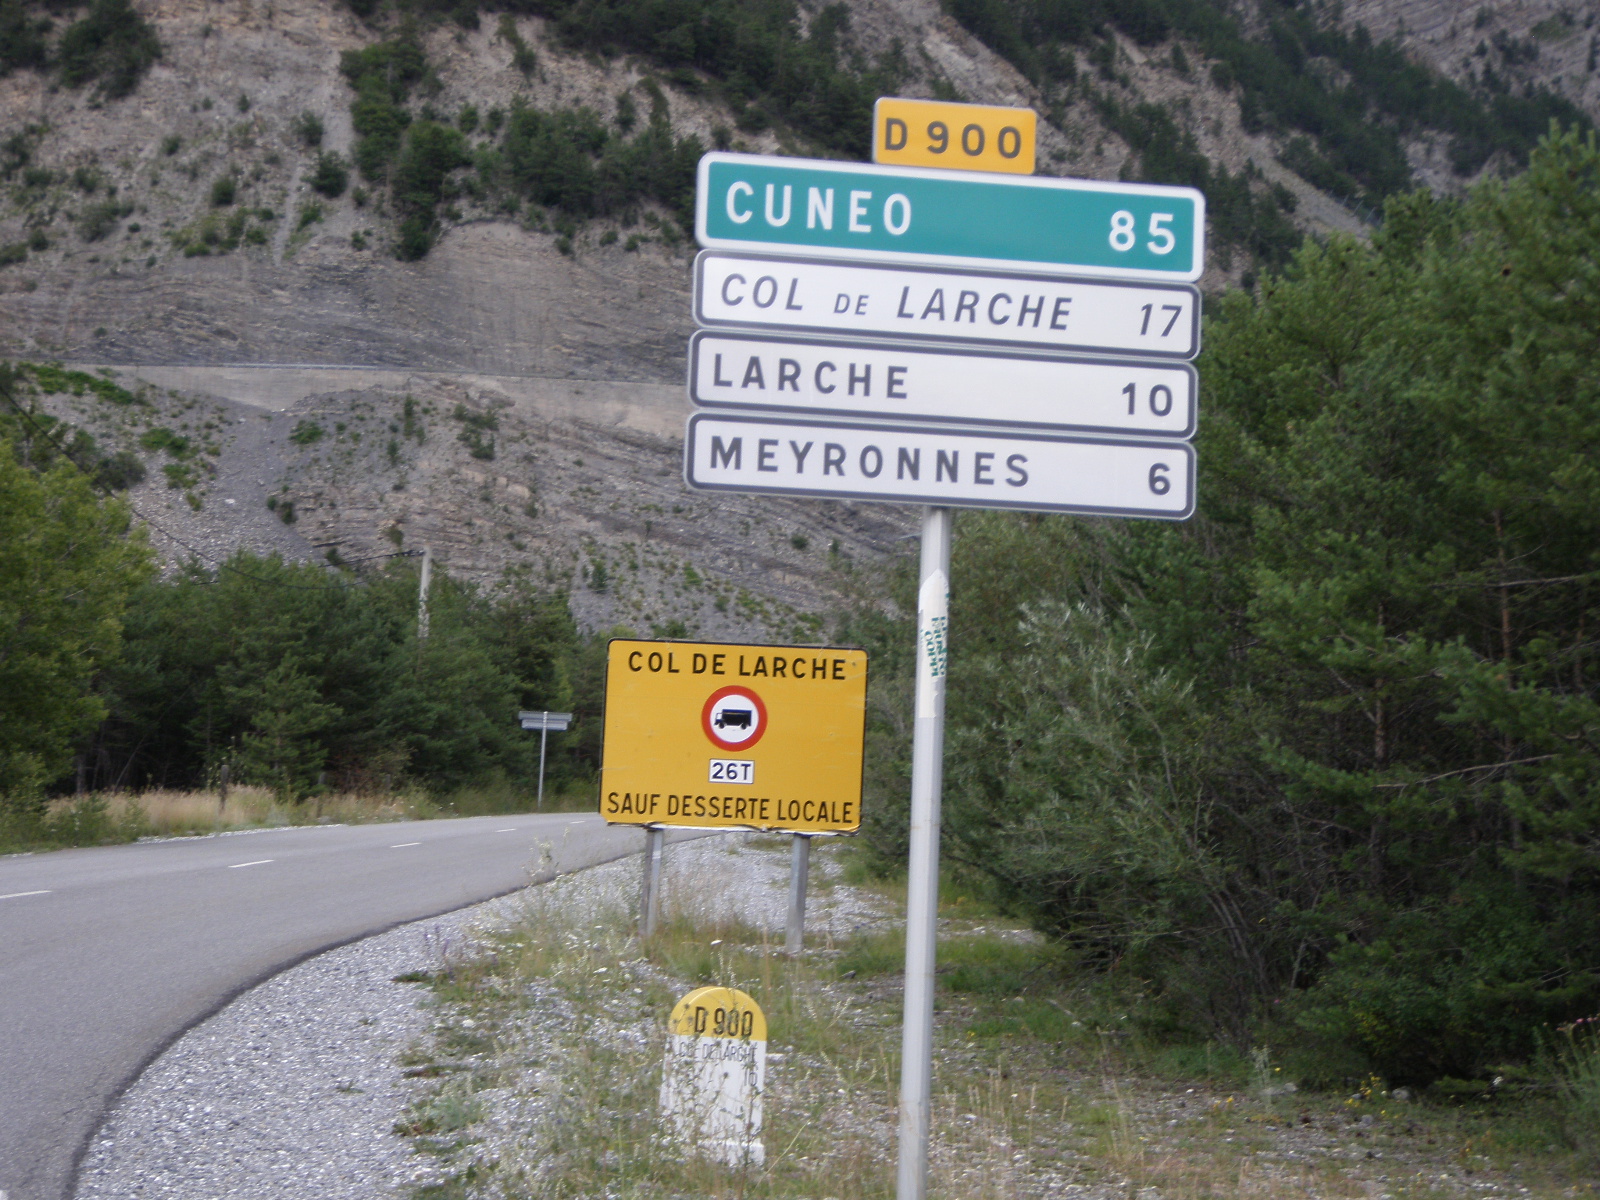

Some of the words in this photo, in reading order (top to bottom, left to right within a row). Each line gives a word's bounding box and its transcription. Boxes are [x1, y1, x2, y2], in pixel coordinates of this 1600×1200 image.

[884, 117, 908, 151] D
[926, 120, 1021, 159] 900
[726, 181, 912, 235] CUNEO
[1108, 210, 1176, 255] 85
[721, 273, 804, 311] COL
[833, 293, 869, 316] DE
[897, 286, 1073, 331] LARCHE
[1139, 303, 1183, 337] 17
[713, 353, 909, 399] LARCHE
[1121, 382, 1173, 417] 10
[710, 435, 1030, 488] MEYRONNES
[1148, 463, 1171, 496] 6
[628, 651, 680, 673] COL
[692, 653, 726, 675] DE
[739, 655, 847, 680] LARCHE
[711, 762, 751, 781] 26T
[607, 791, 661, 815] SAUF
[667, 794, 770, 820] DESSERTE
[777, 799, 853, 823] LOCALE
[694, 1006, 706, 1034] D
[713, 1007, 754, 1037] 900
